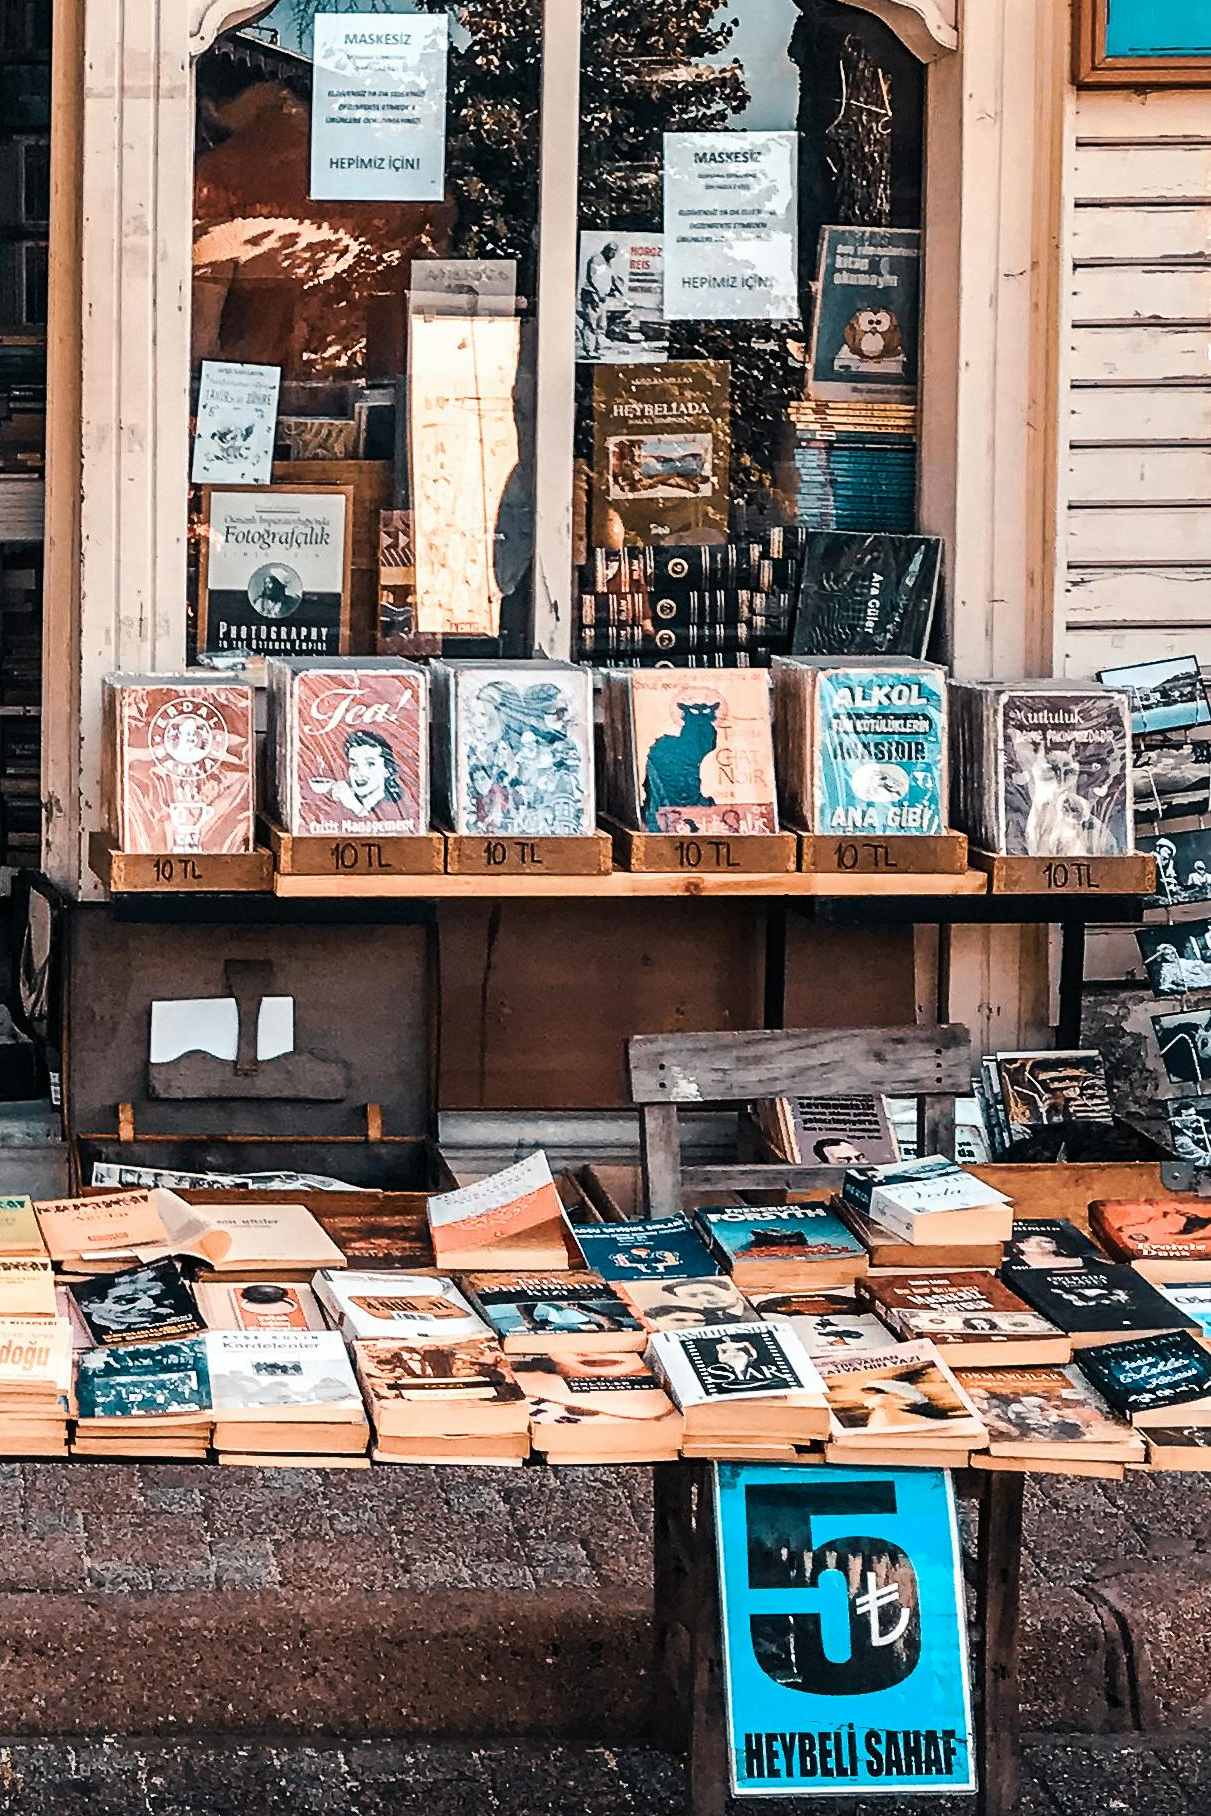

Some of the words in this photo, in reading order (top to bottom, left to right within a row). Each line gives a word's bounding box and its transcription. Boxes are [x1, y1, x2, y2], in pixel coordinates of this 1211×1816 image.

[344, 33, 413, 46] MASKESİZ
[329, 156, 385, 170] HEPİMİZ
[682, 276, 738, 289] HEPİMİZ
[225, 525, 330, 551] Fotoğrafçılık
[869, 572, 884, 596] Ara
[864, 599, 881, 634] Güler
[219, 621, 328, 640] PHOTOGRAPHY
[833, 684, 928, 709] ALKOL
[155, 701, 219, 729] ERDAL
[303, 688, 413, 735] Tea!
[1009, 709, 1084, 726] Mutluluk
[309, 820, 340, 834] Crisis
[341, 819, 415, 835] Management
[832, 806, 878, 828] ANA
[330, 842, 358, 871] 10
[360, 843, 392, 868] TL
[482, 841, 507, 866] 10
[515, 841, 543, 865] TL
[675, 841, 702, 868] 10
[707, 842, 740, 867] TL
[834, 841, 858, 869] 10
[862, 843, 897, 868] TL
[153, 857, 174, 882] 10
[178, 858, 202, 880] TL
[1042, 862, 1068, 889] 10
[1070, 863, 1100, 888] TL
[706, 1209, 827, 1222] FORSYTH
[708, 1364, 794, 1383] STAR
[745, 1481, 922, 1696] 5
[745, 1722, 859, 1778] HEYBELİ
[865, 1729, 958, 1777] SAHAF
